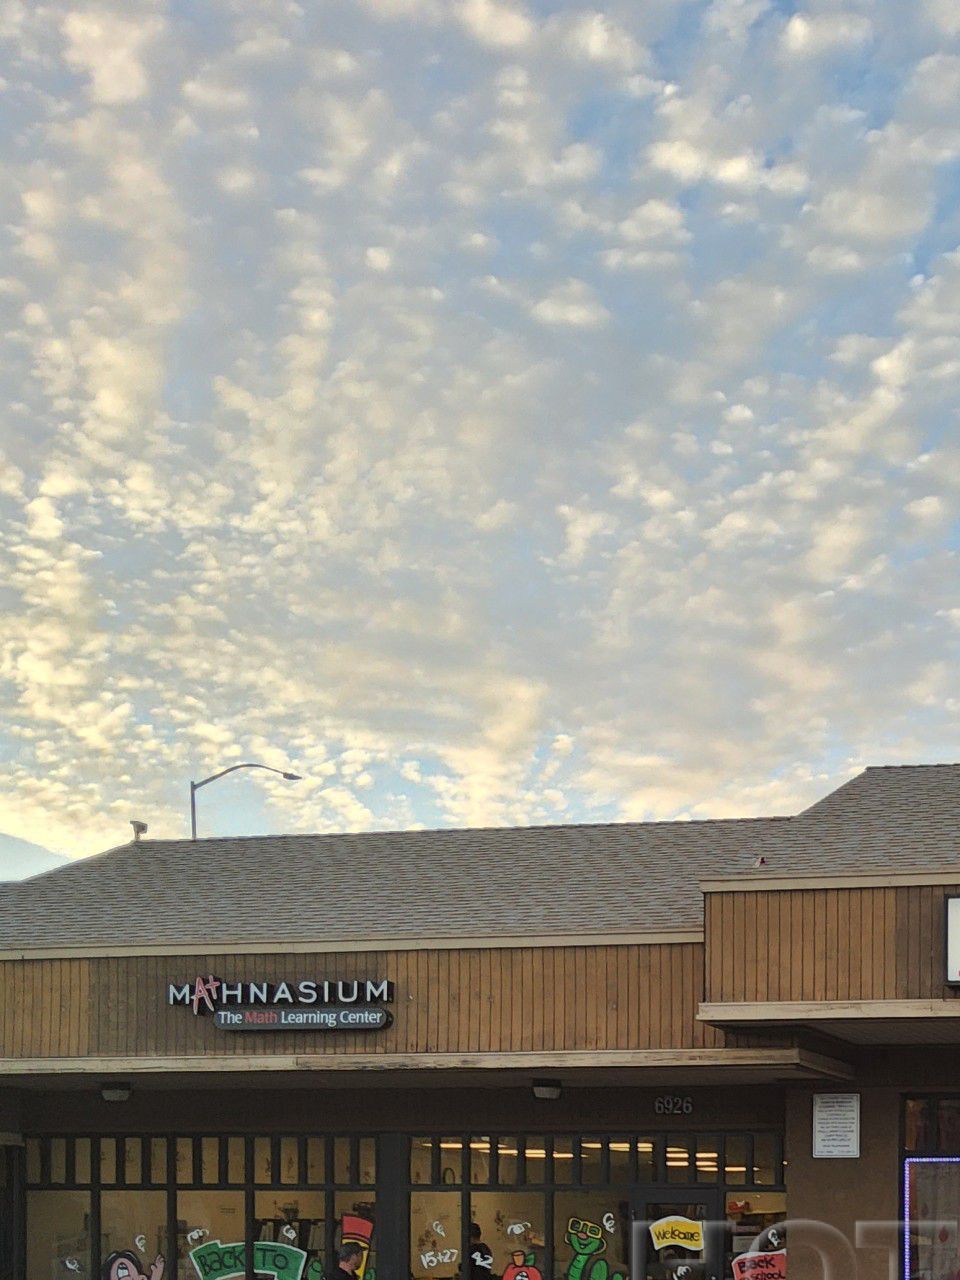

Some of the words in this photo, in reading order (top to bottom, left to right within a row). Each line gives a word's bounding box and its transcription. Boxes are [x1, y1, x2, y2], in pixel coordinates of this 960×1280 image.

[168, 974, 389, 1015] MATHNASIUM
[218, 1010, 242, 1024] The
[245, 1010, 277, 1024] Math
[281, 1010, 336, 1027] Learning
[339, 1009, 383, 1024] Center
[655, 1096, 693, 1115] 6926
[420, 1248, 459, 1269] 15+27
